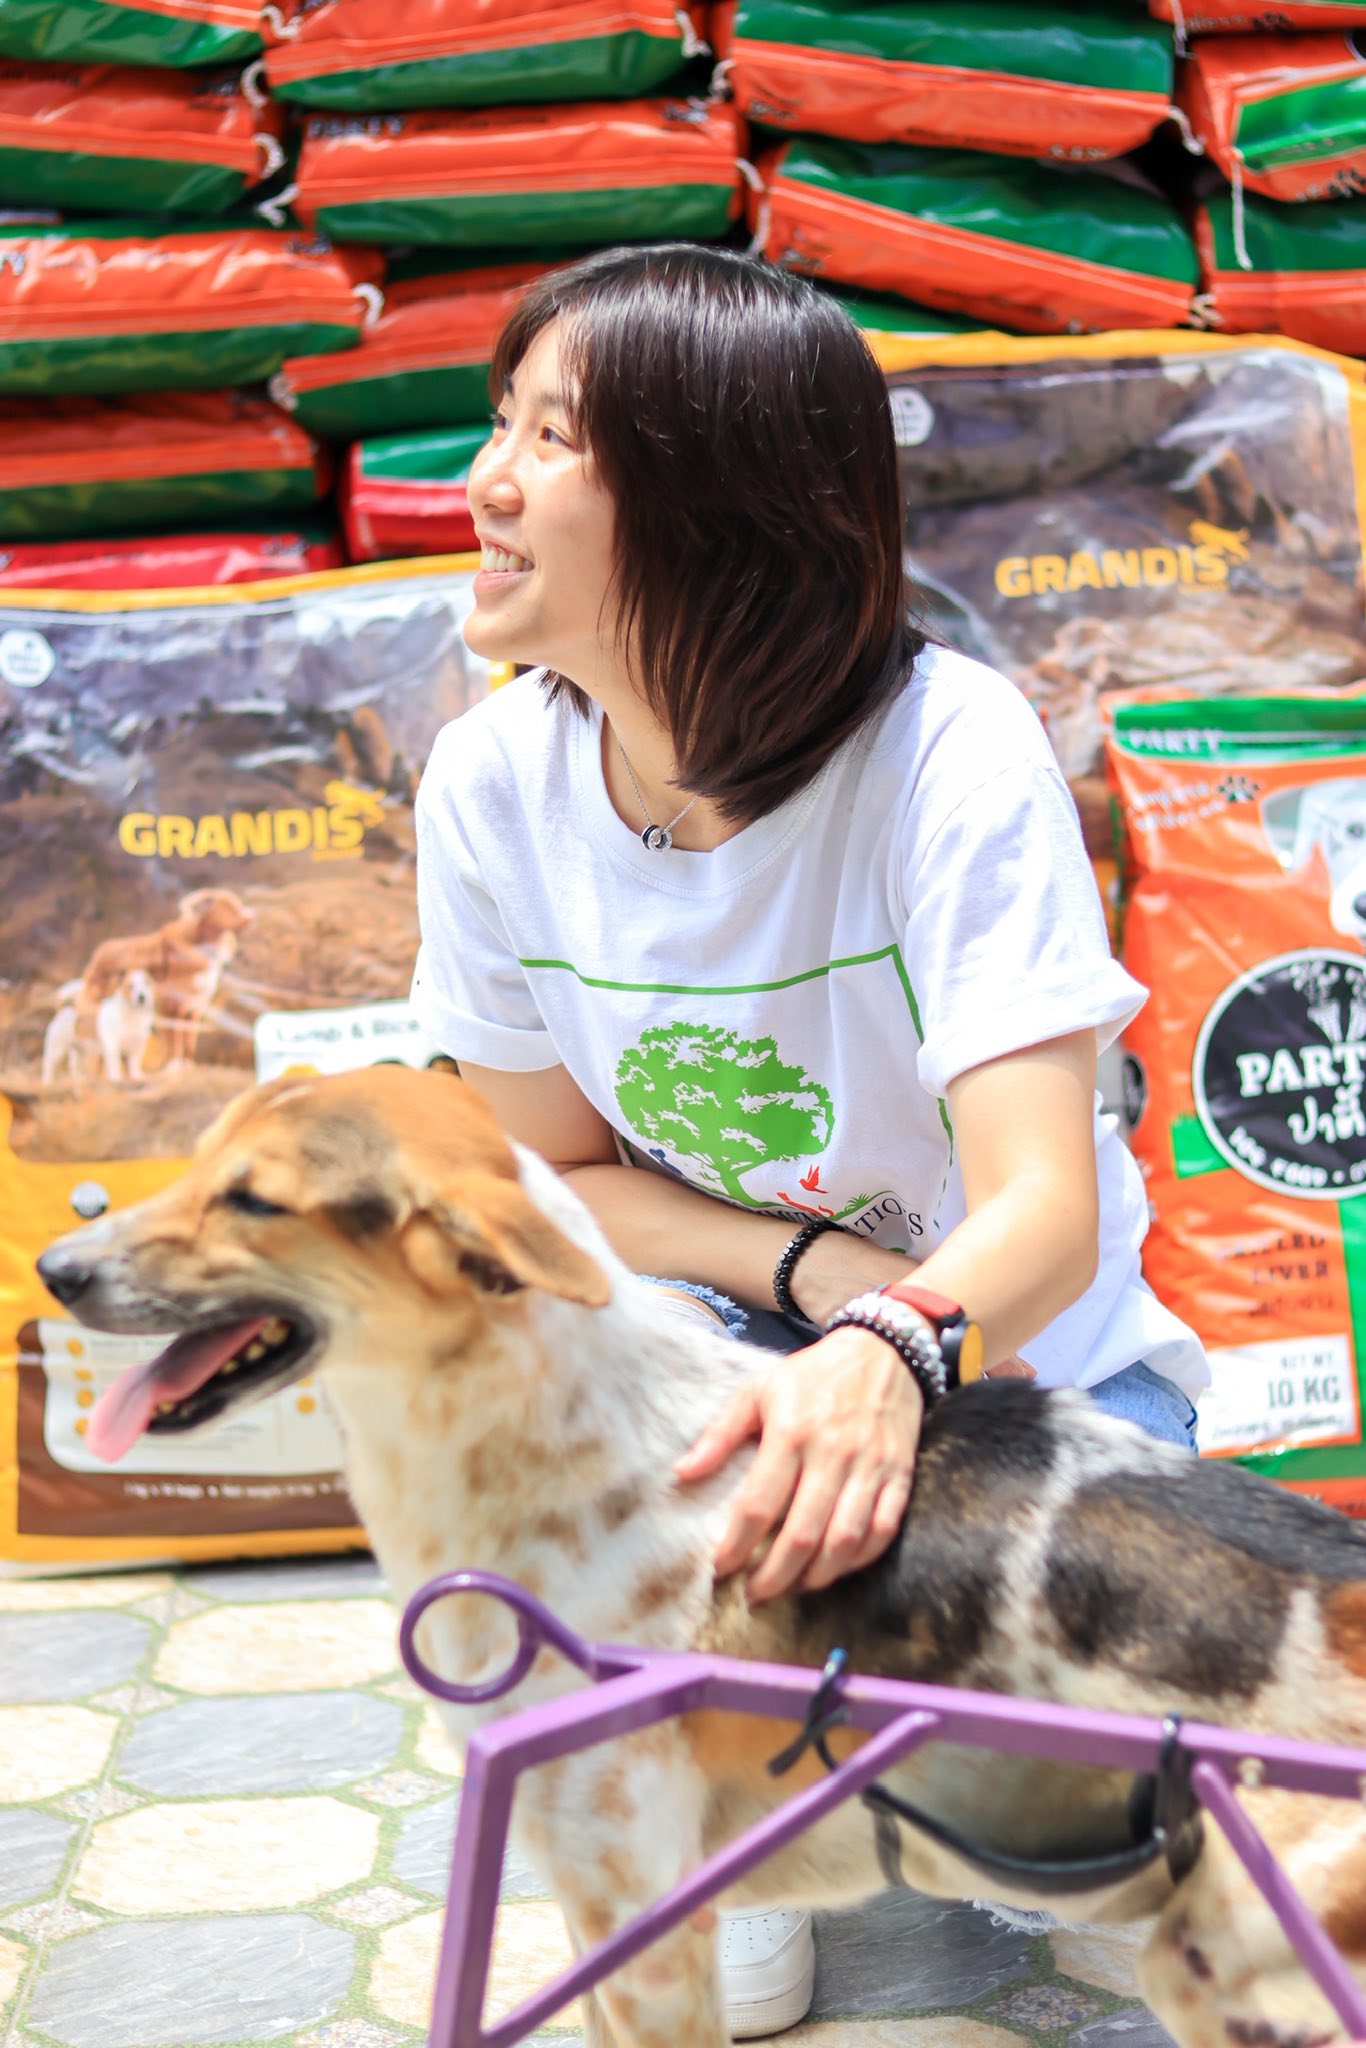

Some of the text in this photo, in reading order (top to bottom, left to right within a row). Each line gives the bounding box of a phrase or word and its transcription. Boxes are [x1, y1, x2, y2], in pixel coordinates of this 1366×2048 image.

[994, 546, 1229, 598] GRANDIS
[118, 805, 365, 859] GRANDIS
[1236, 1042, 1366, 1098] PART
[1267, 1375, 1341, 1409] 10 KG
